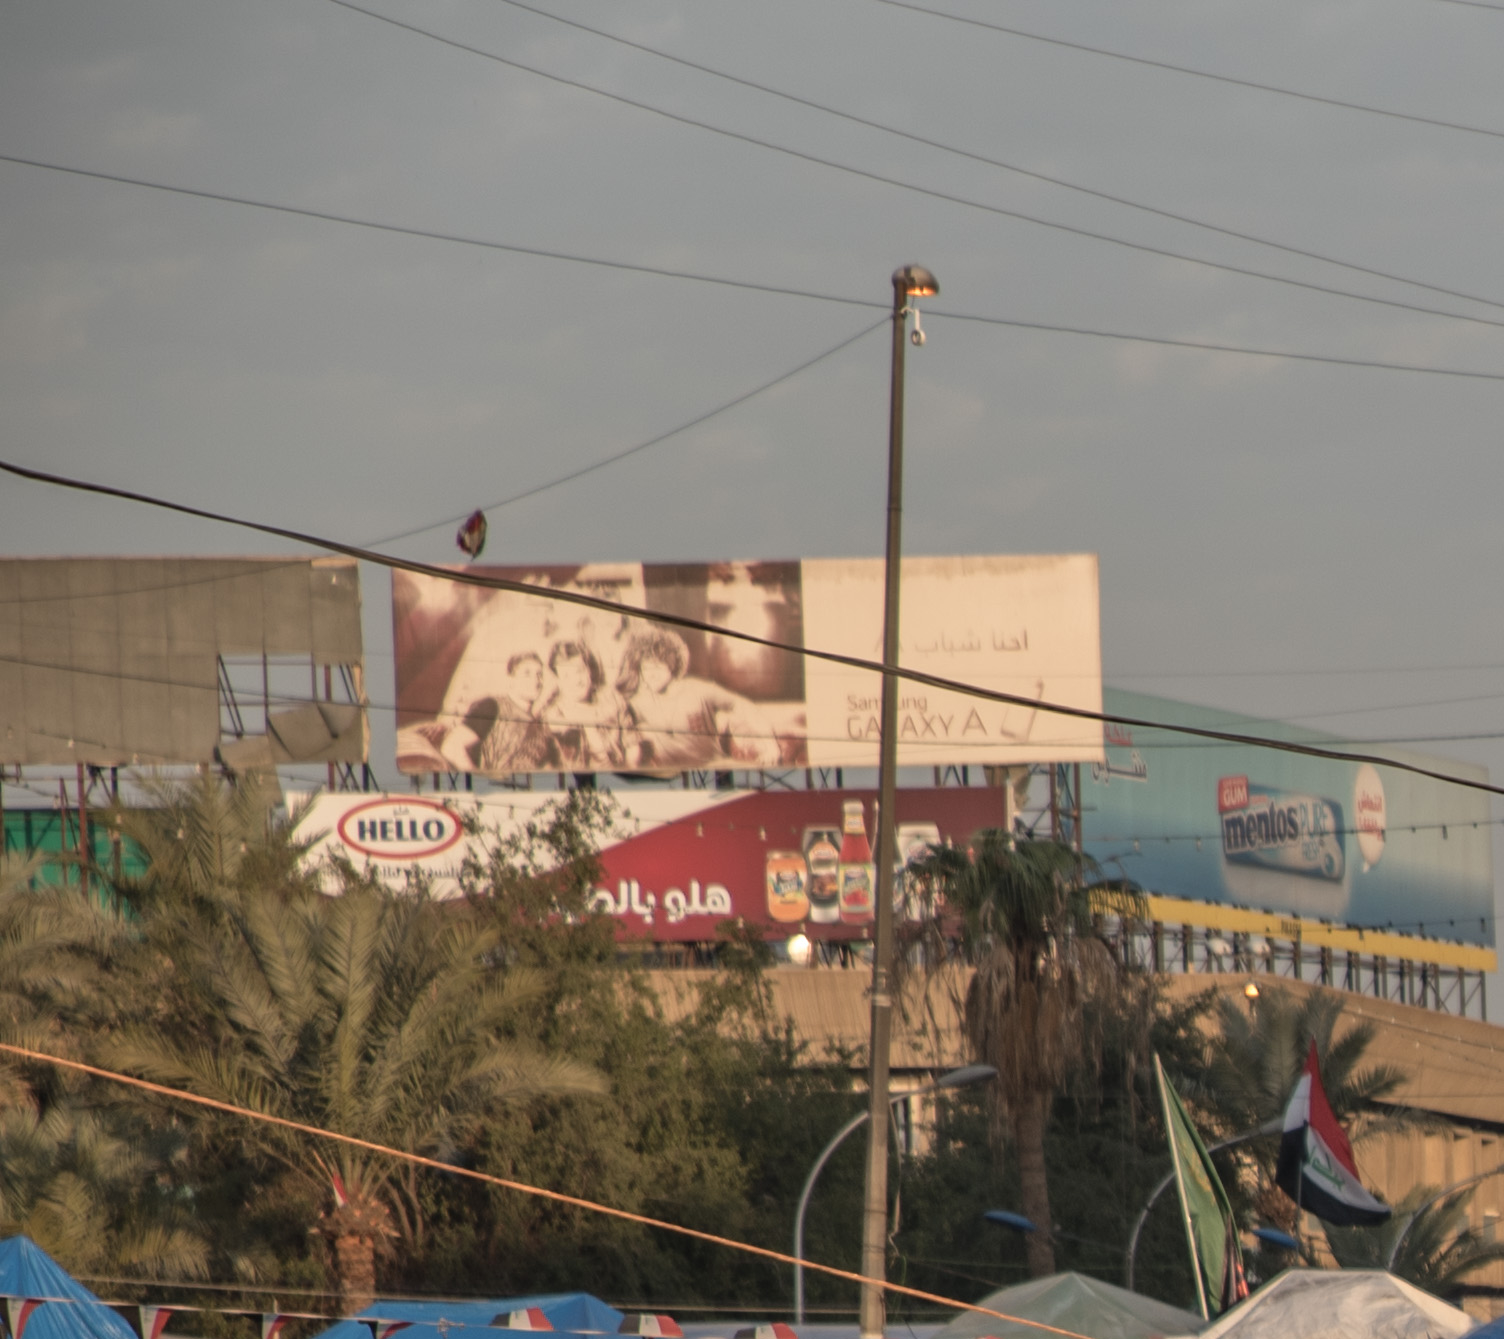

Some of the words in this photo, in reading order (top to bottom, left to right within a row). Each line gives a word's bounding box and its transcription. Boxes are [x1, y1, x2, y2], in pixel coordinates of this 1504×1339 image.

[847, 715, 955, 741] GAAXY
[357, 819, 446, 842] HELLO
[1223, 801, 1299, 852] mentos
